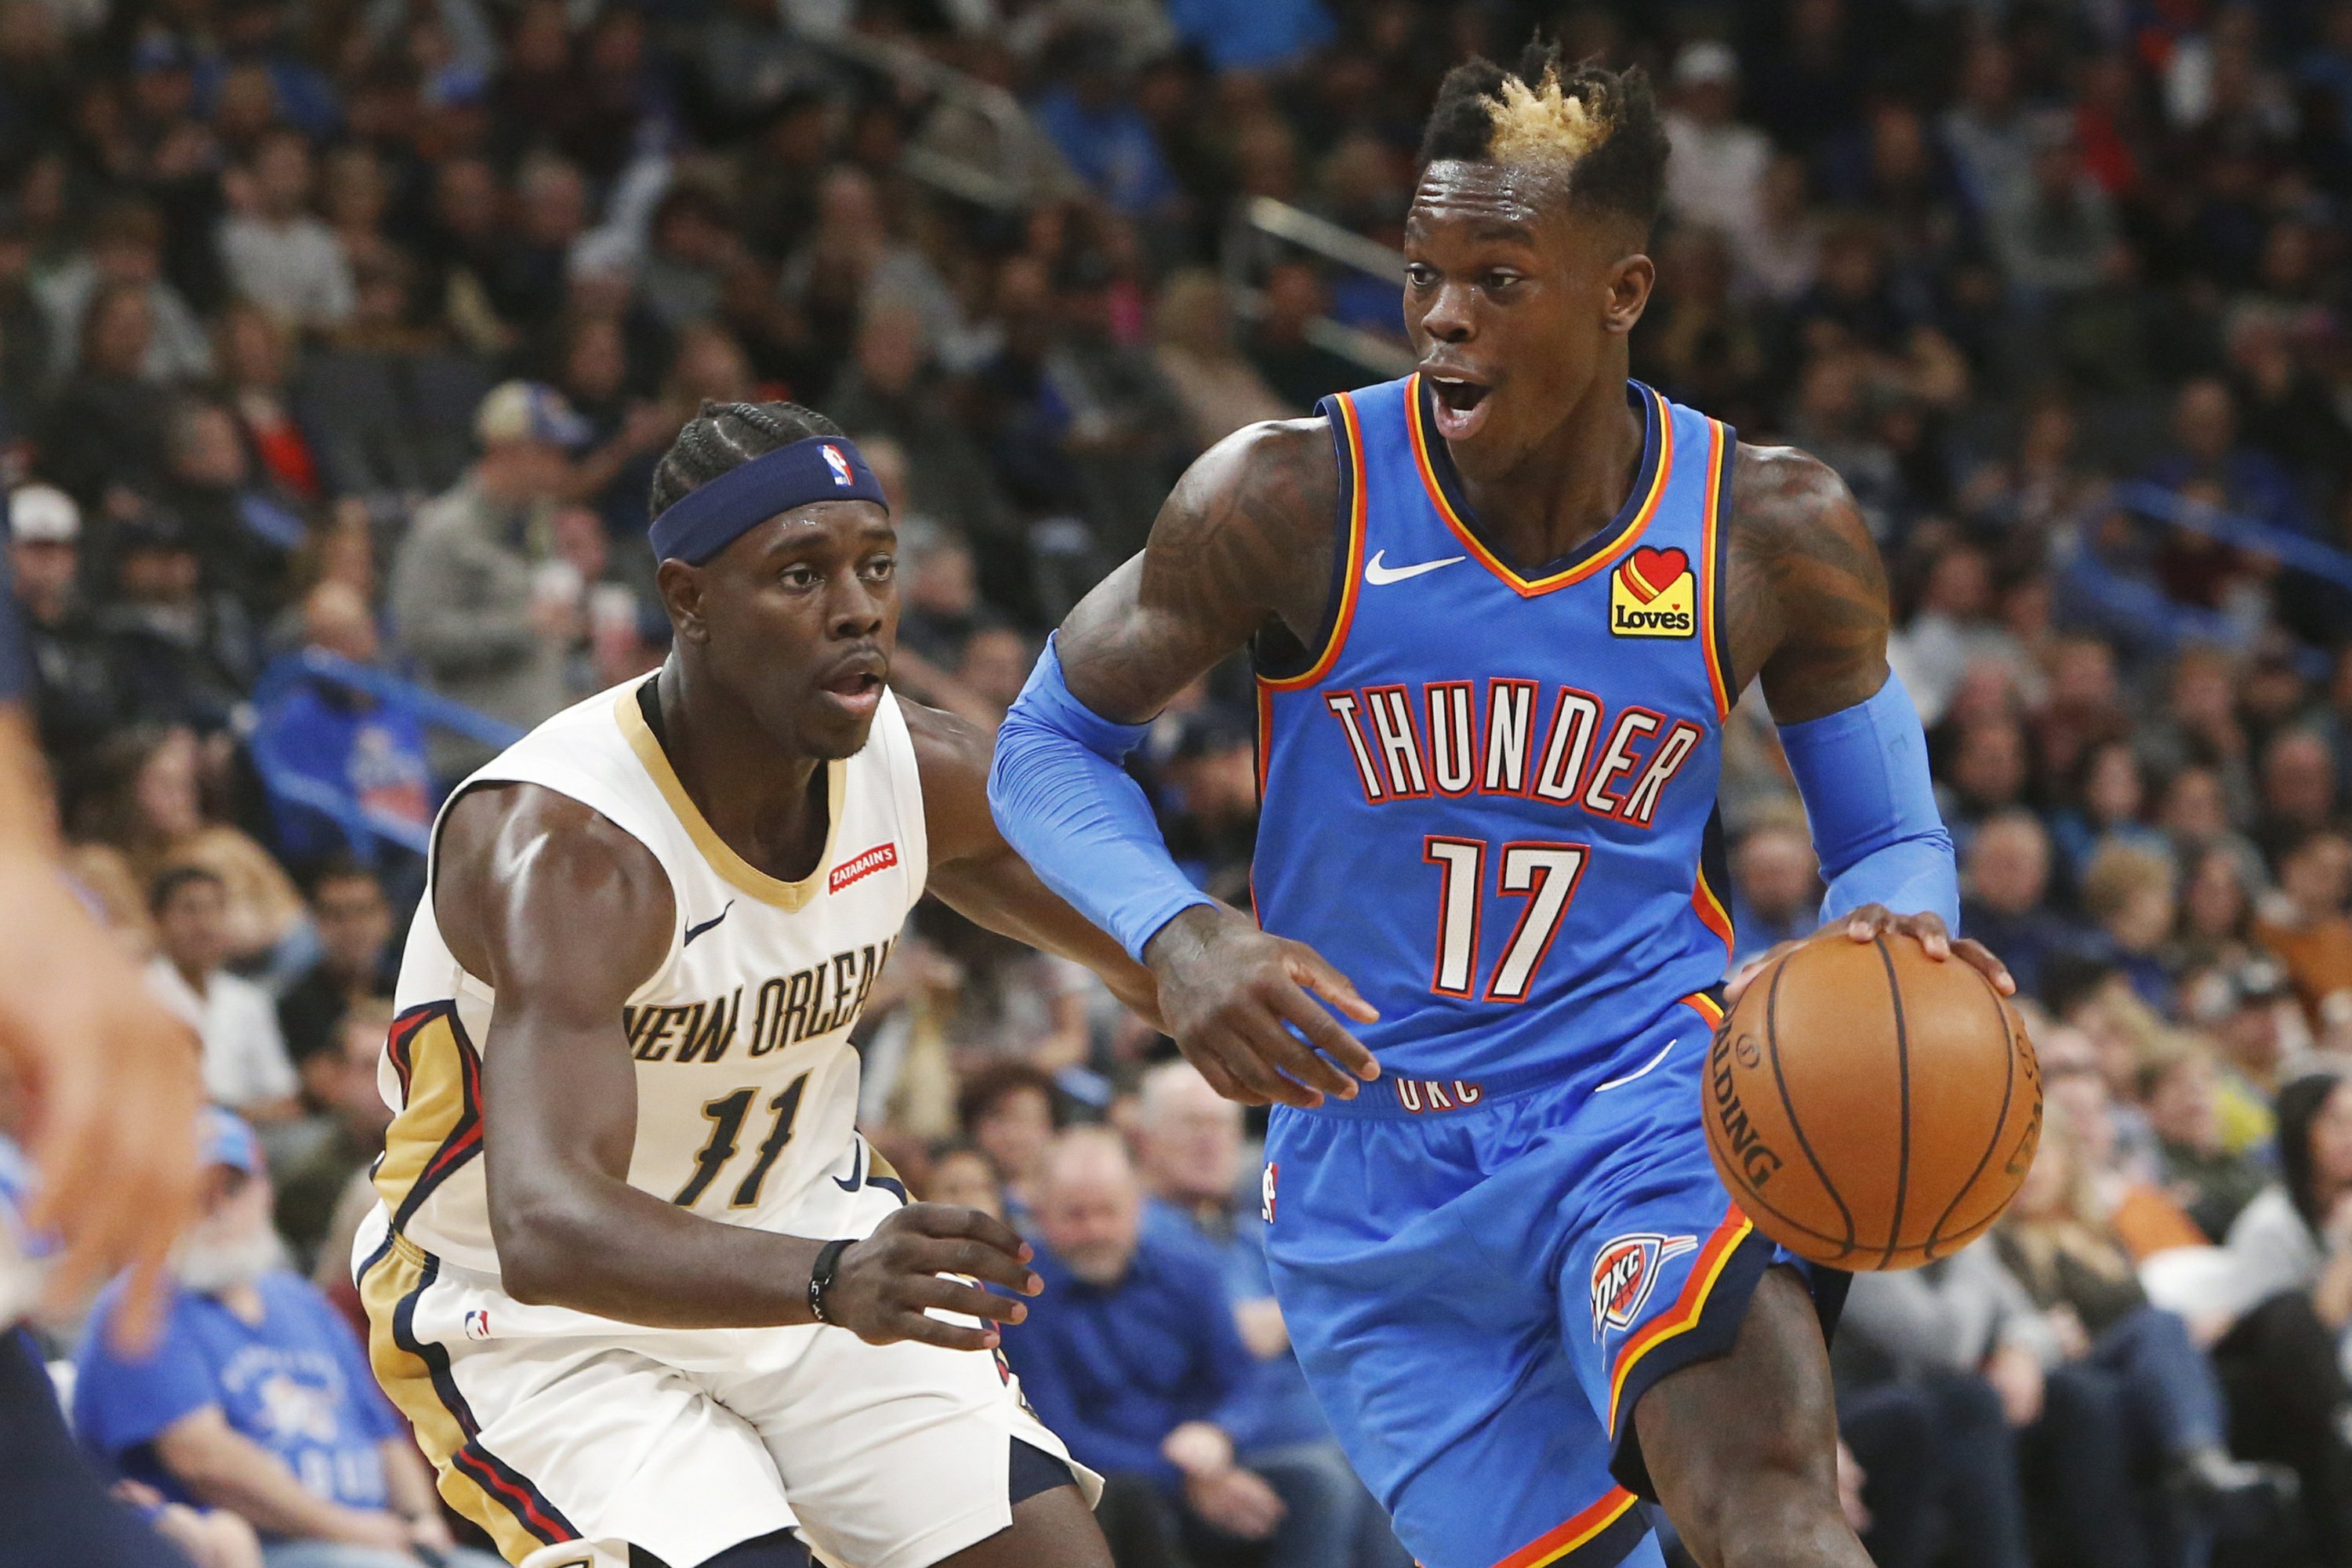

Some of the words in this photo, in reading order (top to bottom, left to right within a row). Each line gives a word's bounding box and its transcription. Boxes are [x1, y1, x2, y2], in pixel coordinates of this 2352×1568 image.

[1323, 678, 1702, 828] THUNDER
[1423, 835, 1590, 1004] 17
[670, 1068, 814, 1210] 11
[1595, 1247, 1640, 1332] OKC
